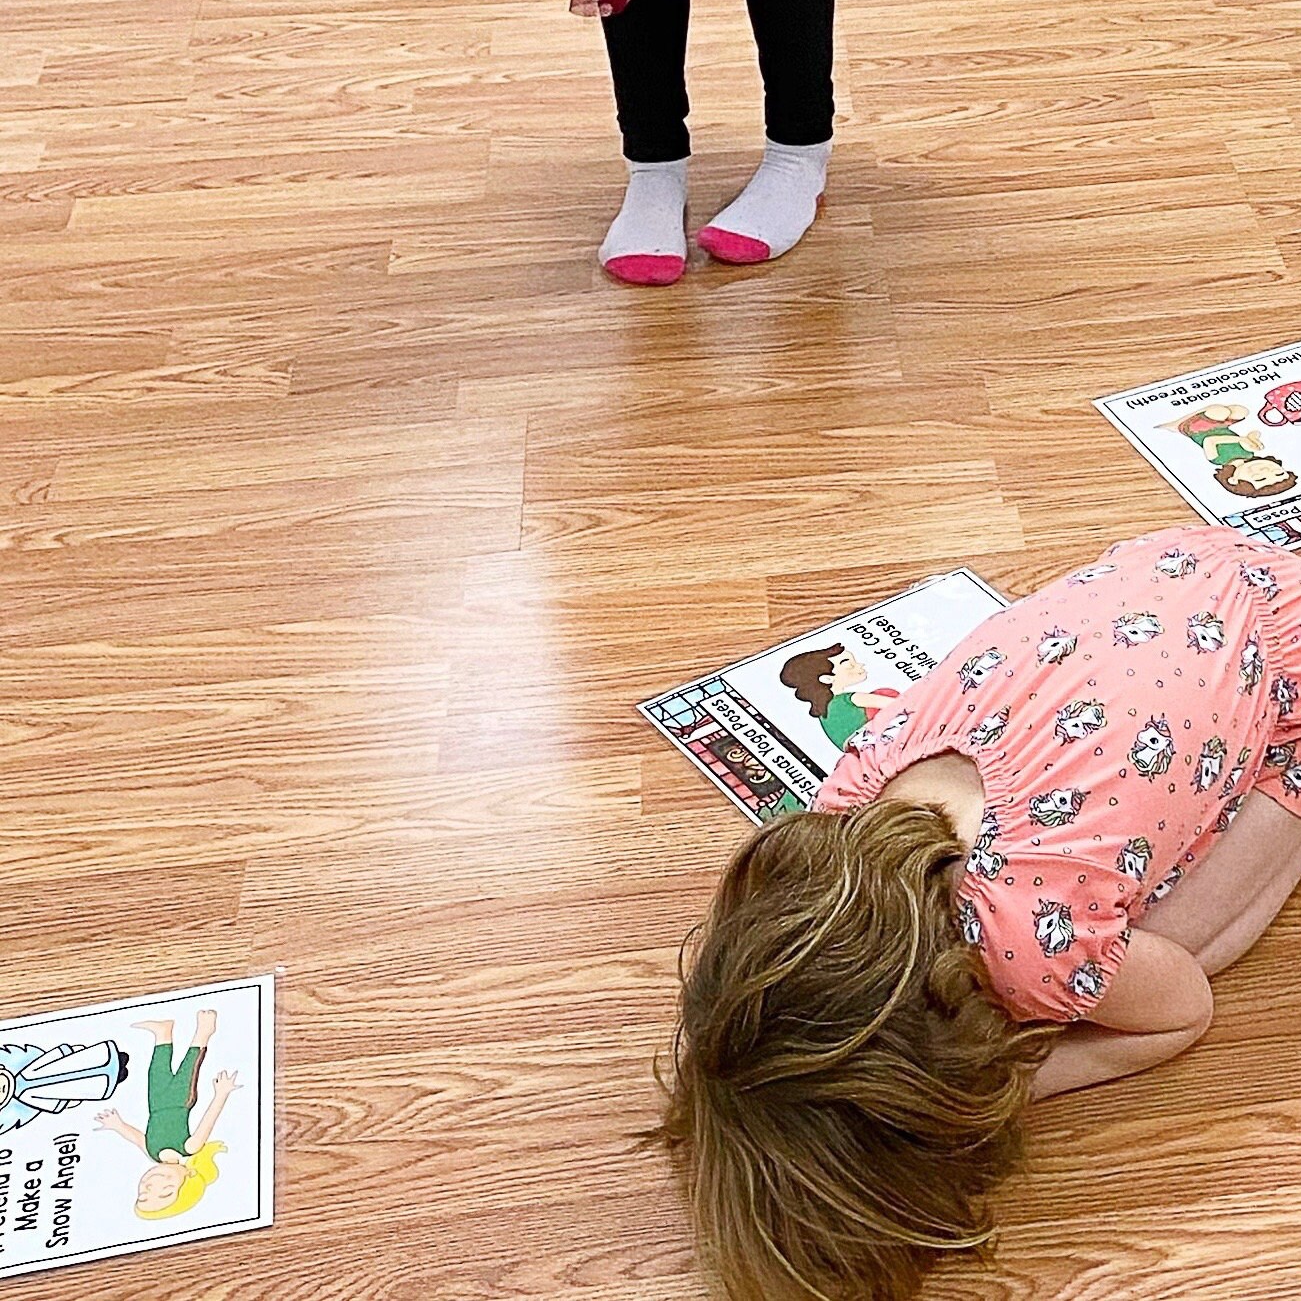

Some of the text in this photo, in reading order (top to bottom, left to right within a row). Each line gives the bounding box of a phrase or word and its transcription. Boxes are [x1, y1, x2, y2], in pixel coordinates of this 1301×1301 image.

[1126, 386, 1189, 410] Breath)
[1170, 371, 1281, 407] Hot Chocolate
[1191, 364, 1268, 390] Chocolate
[1253, 505, 1301, 523] Poses
[846, 623, 922, 681] mp of Coal
[867, 615, 938, 669] ild's Pose)
[711, 699, 815, 796] istmas Yoga Poses
[13, 1159, 44, 1232] Make a
[45, 1133, 80, 1249] Snow Angel)
